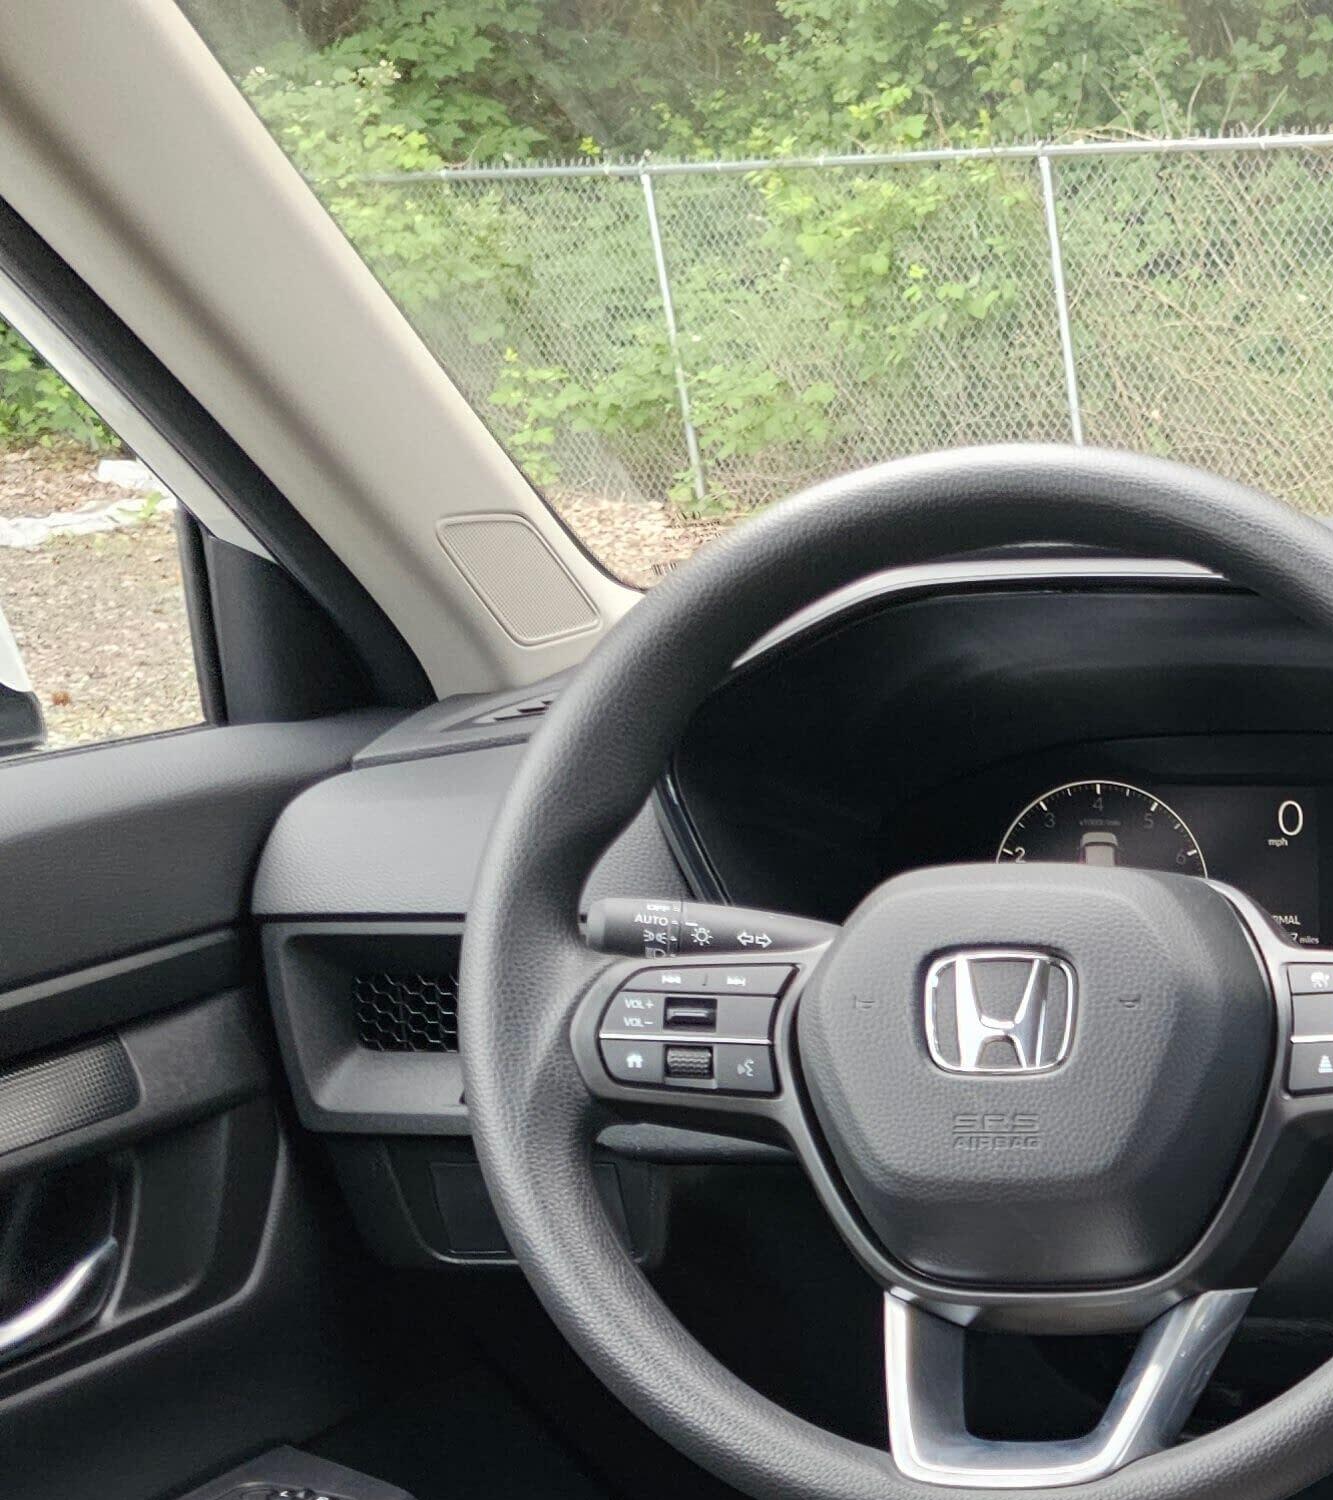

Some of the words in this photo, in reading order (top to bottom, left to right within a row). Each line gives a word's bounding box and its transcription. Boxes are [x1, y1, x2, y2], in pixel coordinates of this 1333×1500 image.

[1277, 800, 1304, 836] 0
[1268, 837, 1289, 848] mph
[1014, 847, 1026, 864] 2
[634, 913, 669, 927] AUTO
